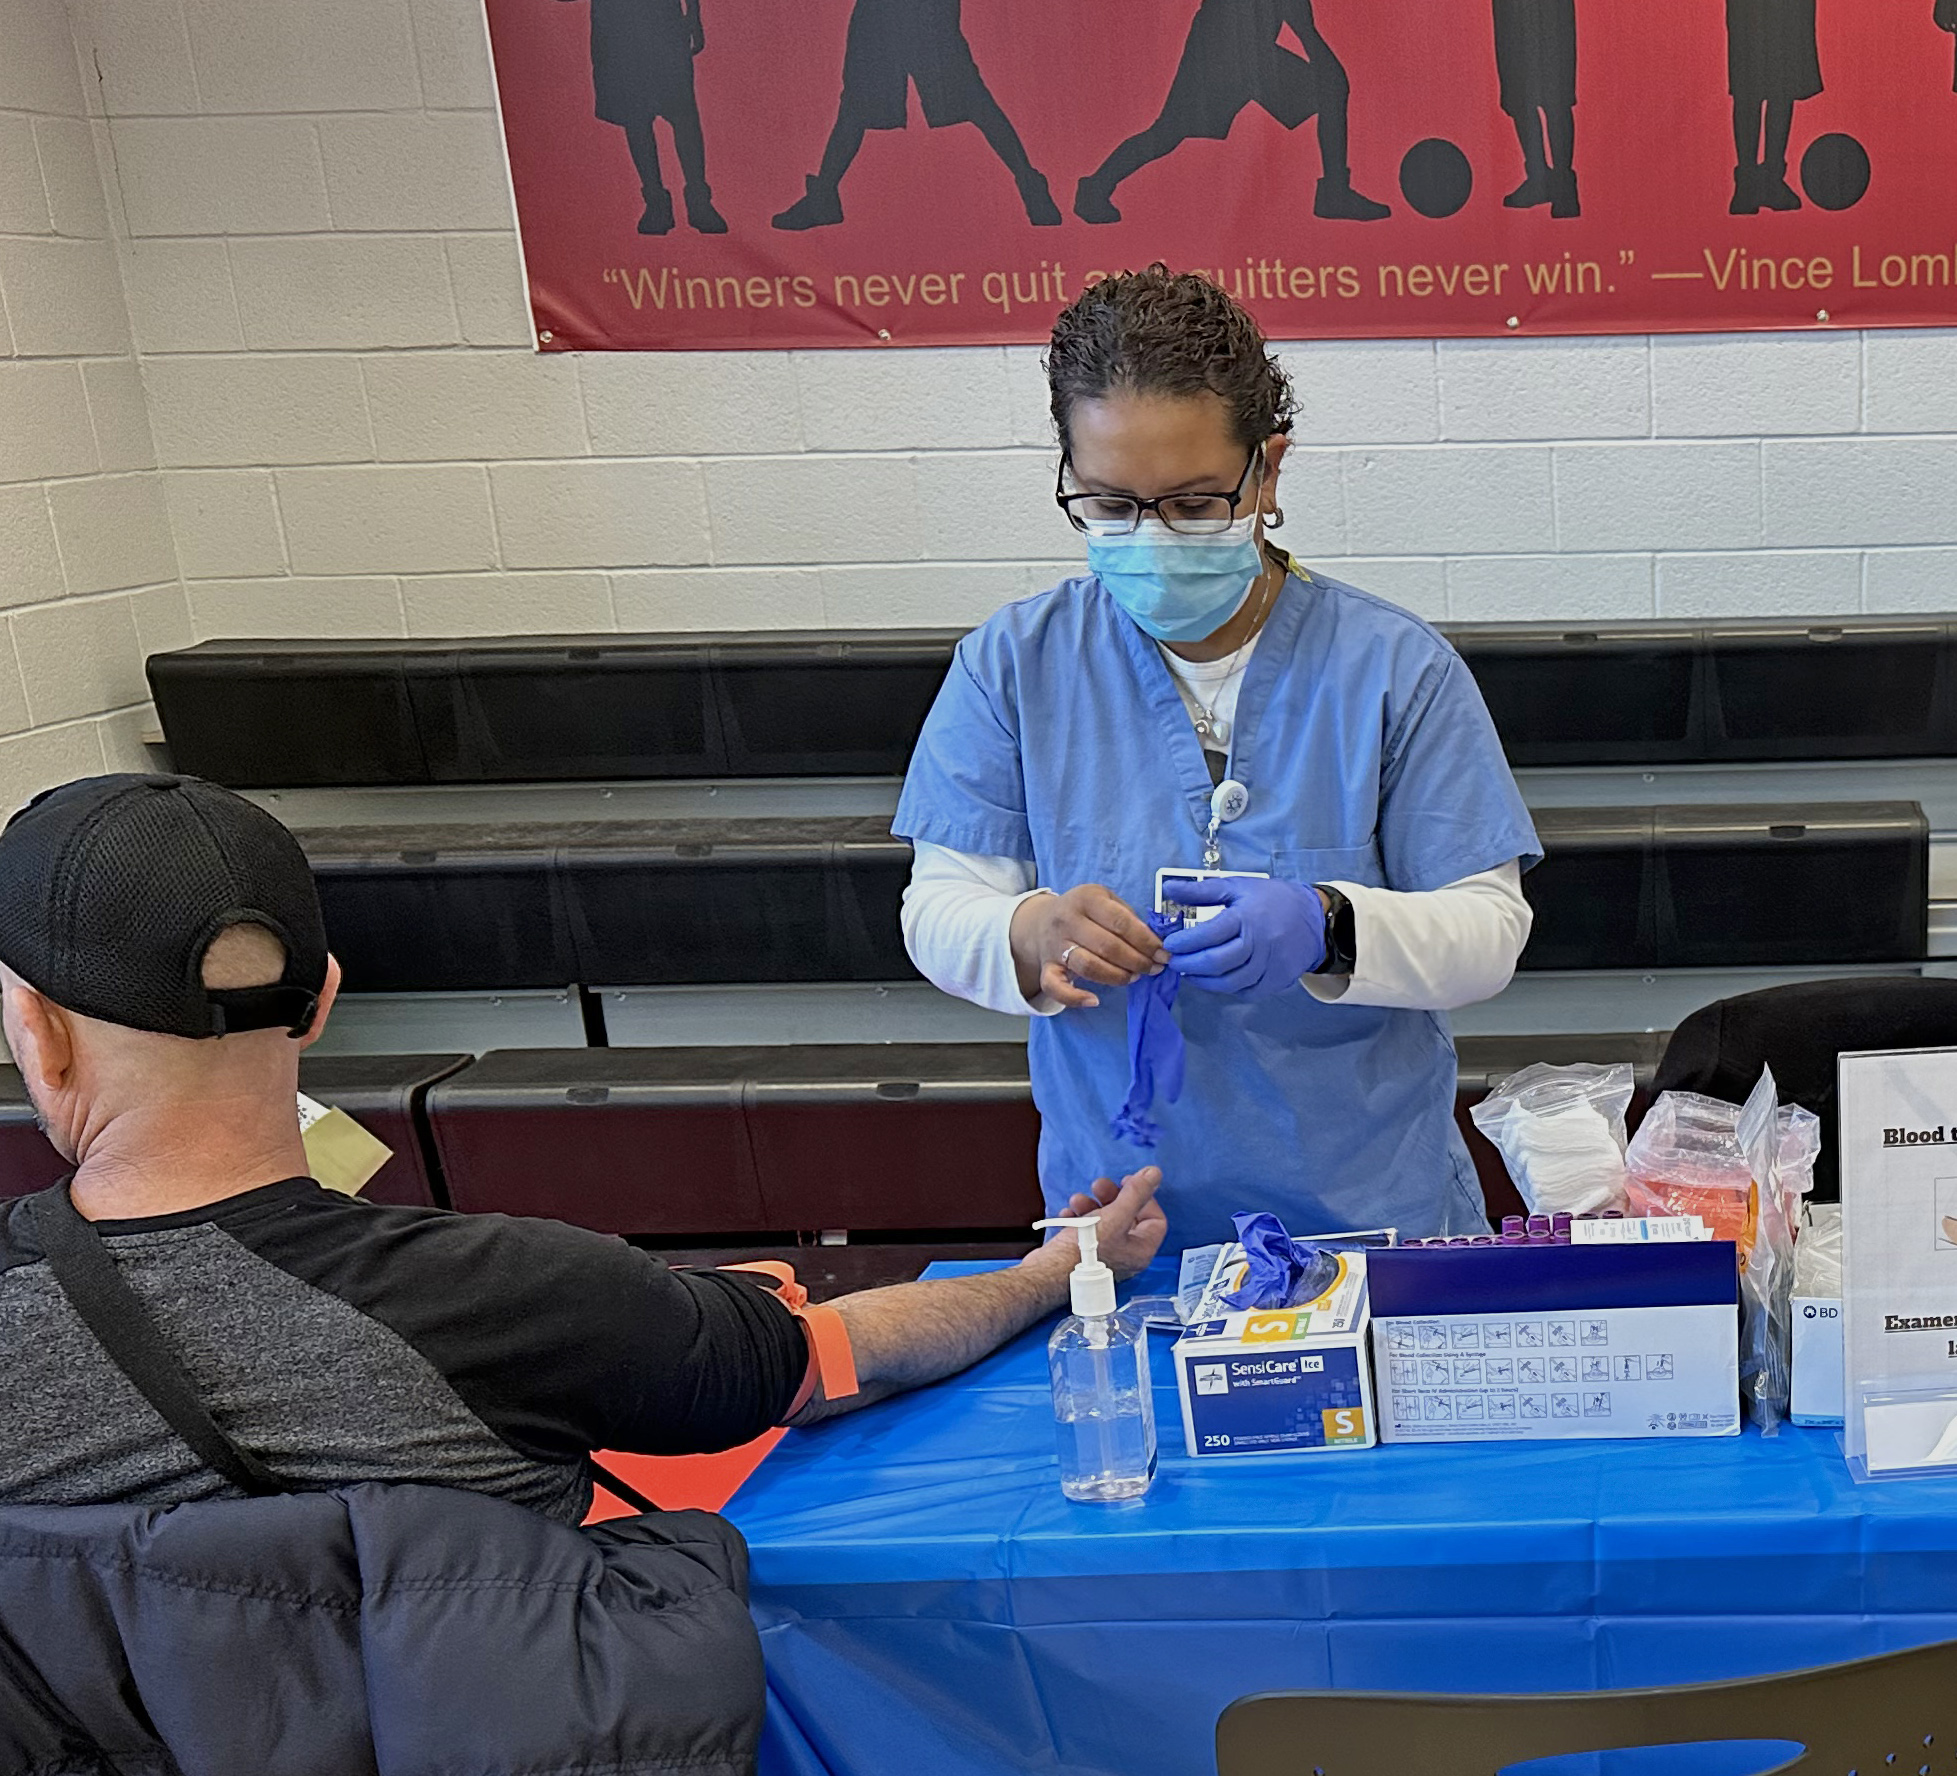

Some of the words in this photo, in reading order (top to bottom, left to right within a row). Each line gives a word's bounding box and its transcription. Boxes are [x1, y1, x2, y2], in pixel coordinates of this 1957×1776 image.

[603, 267, 817, 310] “Winners
[834, 273, 965, 306] never
[982, 260, 1069, 314] quit
[1190, 256, 1361, 300] uitters
[1378, 263, 1510, 297] never
[1524, 250, 1635, 294] win.”
[1883, 1125, 1945, 1145] Blood
[1819, 1307, 1838, 1319] BD
[1304, 1359, 1320, 1369] Ice
[1232, 1379, 1251, 1388] with
[1335, 1411, 1354, 1434] S
[1204, 1434, 1230, 1447] 250
